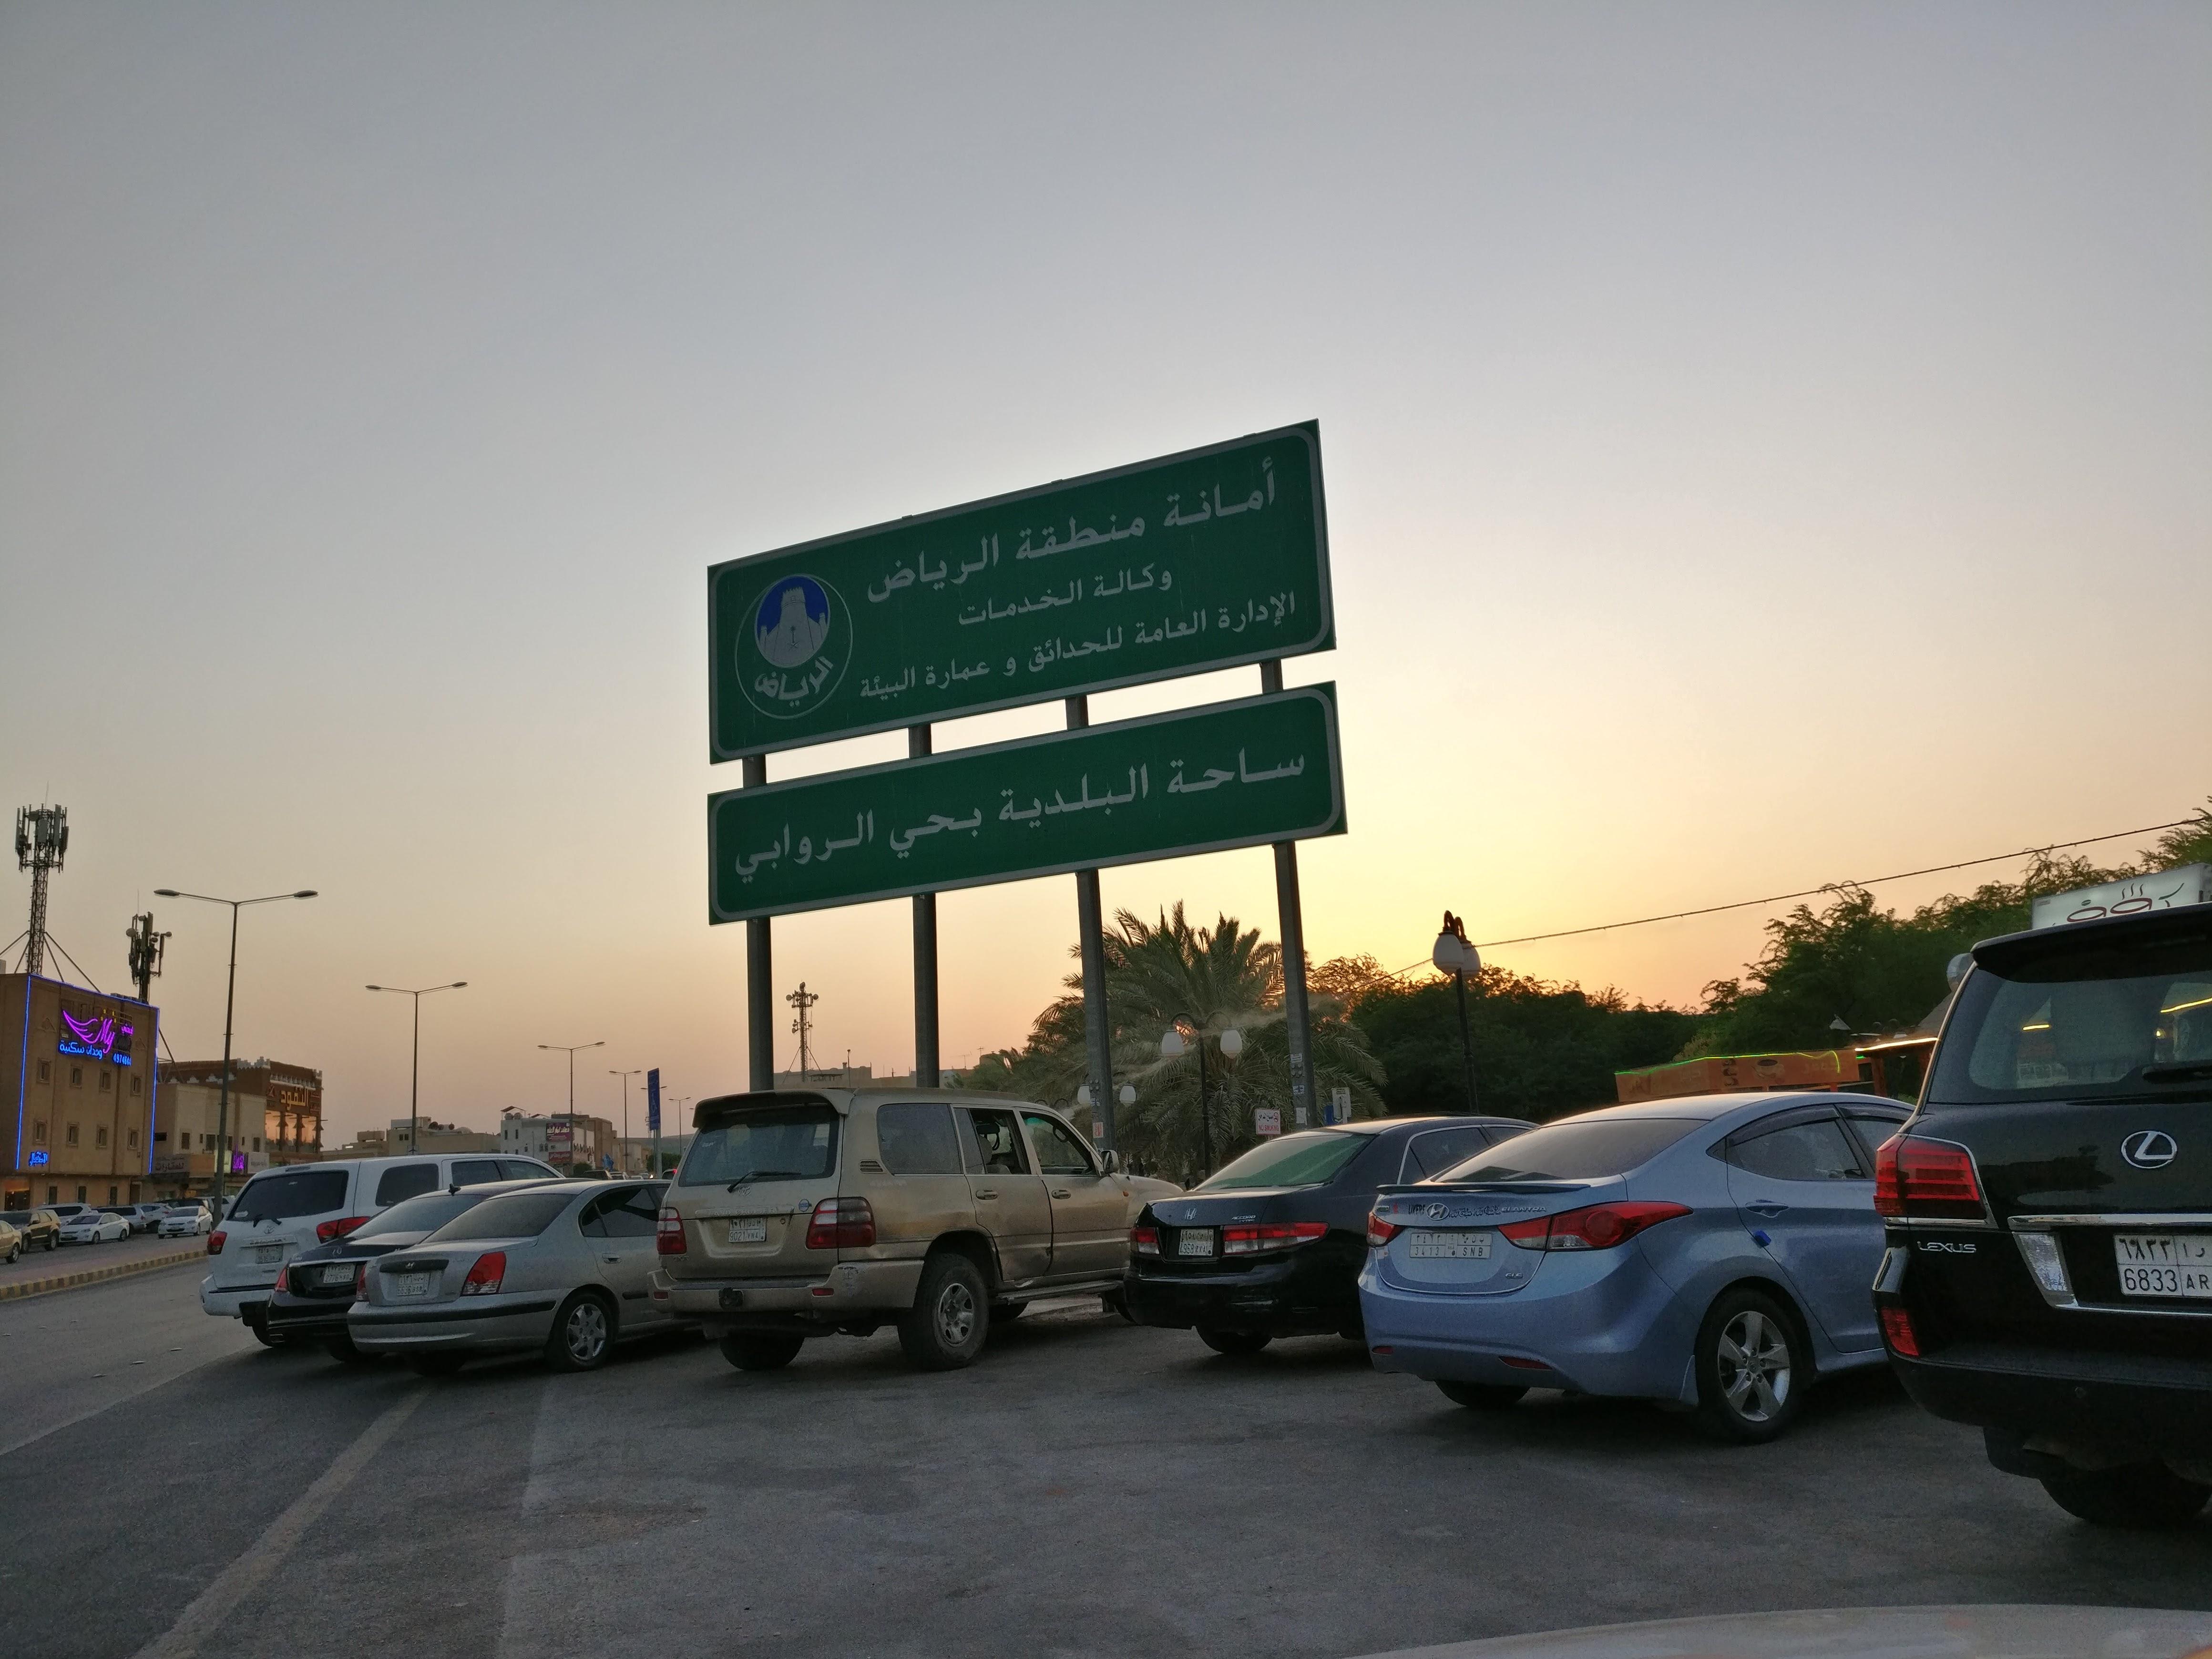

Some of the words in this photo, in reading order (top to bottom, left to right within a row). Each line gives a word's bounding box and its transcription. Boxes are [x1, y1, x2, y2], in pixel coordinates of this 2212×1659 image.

[1164, 456, 1275, 526] أمانة
[1015, 515, 1145, 560] منطقة
[867, 534, 999, 602] الرياض
[1094, 563, 1172, 597] وكالة
[958, 578, 1083, 625] الخدمات
[1218, 591, 1295, 631] الإدارة
[1135, 609, 1207, 644] العامة
[1003, 656, 1016, 676] و
[1028, 626, 1123, 672] للحدائق
[755, 656, 834, 707] الرياض
[860, 667, 916, 700] البيئة
[925, 659, 990, 694] عمارة
[1167, 748, 1304, 793] ساحة
[999, 763, 1148, 828] البلدية
[736, 809, 874, 883] الروابي
[890, 808, 982, 859] بحي
[60, 1040, 85, 1054] سكنية
[736, 1208, 776, 1216] CRUISER
[1501, 1206, 1546, 1214] ELANTRA
[1415, 1246, 1439, 1256] 3413
[1463, 1247, 1484, 1257] SNB
[1916, 1241, 1976, 1254] LEXUS
[2124, 1268, 2178, 1292] 6833
